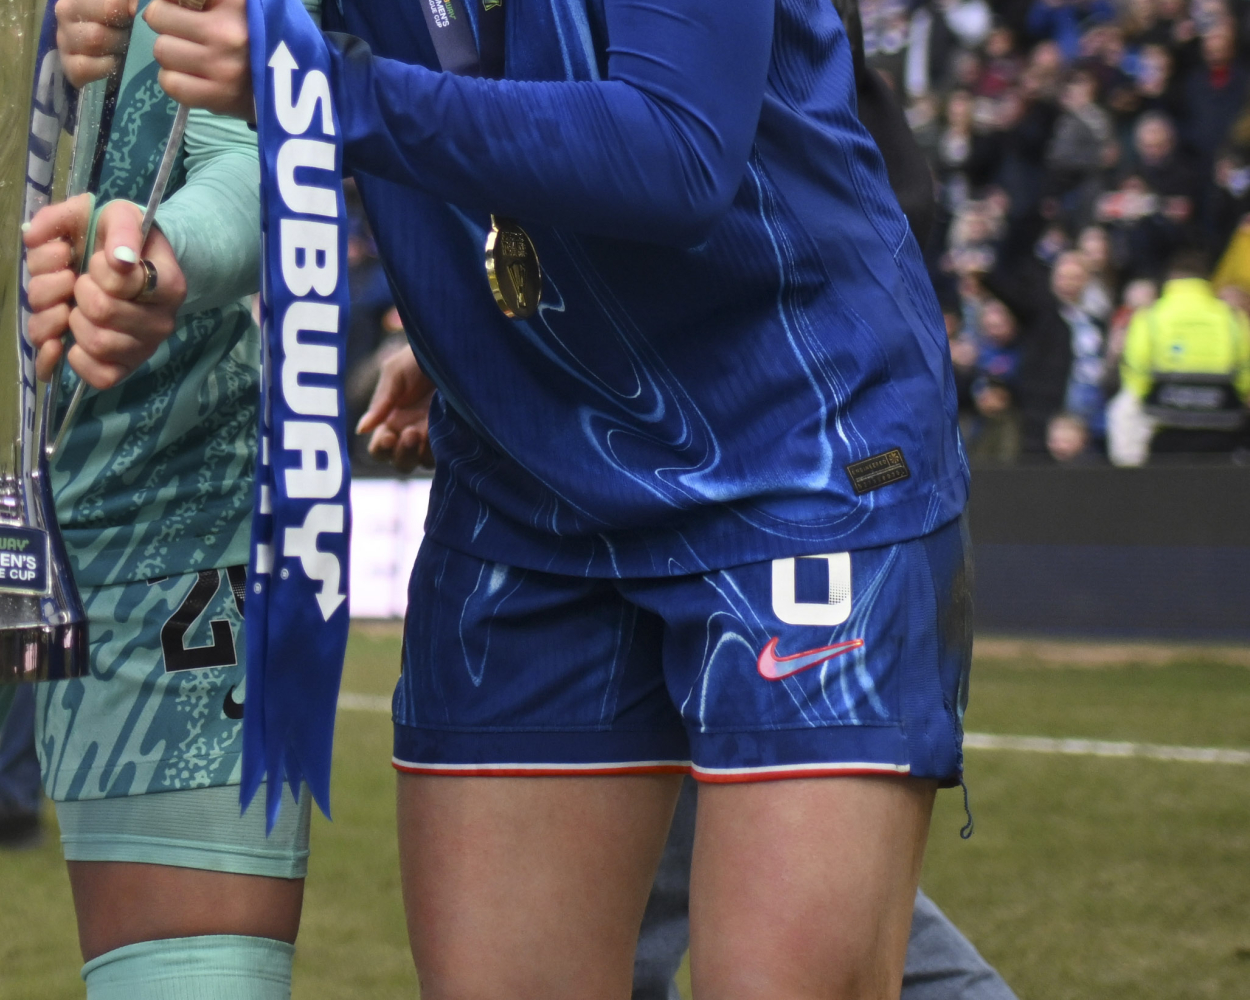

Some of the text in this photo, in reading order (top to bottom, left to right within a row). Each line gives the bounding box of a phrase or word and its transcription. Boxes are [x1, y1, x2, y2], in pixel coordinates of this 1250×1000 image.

[434, 15, 442, 28] CUP
[267, 40, 346, 622] SUBWAY
[10, 569, 36, 581] CUP
